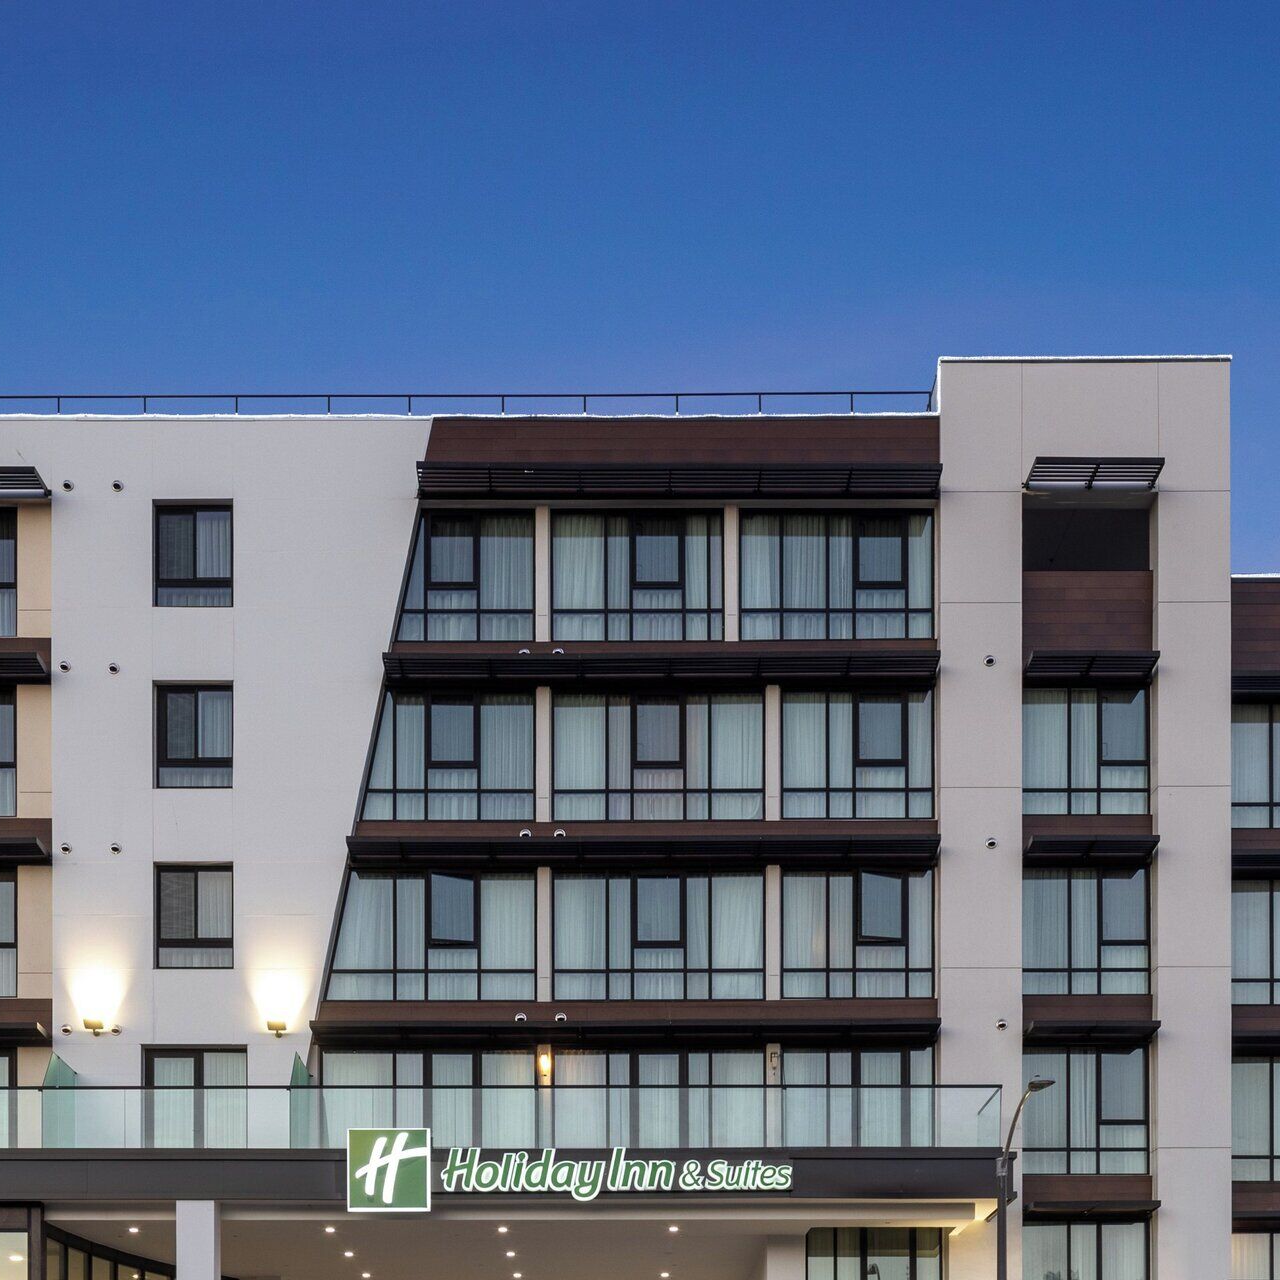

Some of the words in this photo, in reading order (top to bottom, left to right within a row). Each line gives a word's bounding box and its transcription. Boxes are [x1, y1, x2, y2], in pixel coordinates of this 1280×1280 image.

[442, 1147, 603, 1201] Holiday
[609, 1146, 674, 1191] Inn
[679, 1160, 703, 1190] &
[706, 1159, 793, 1191] Suites
